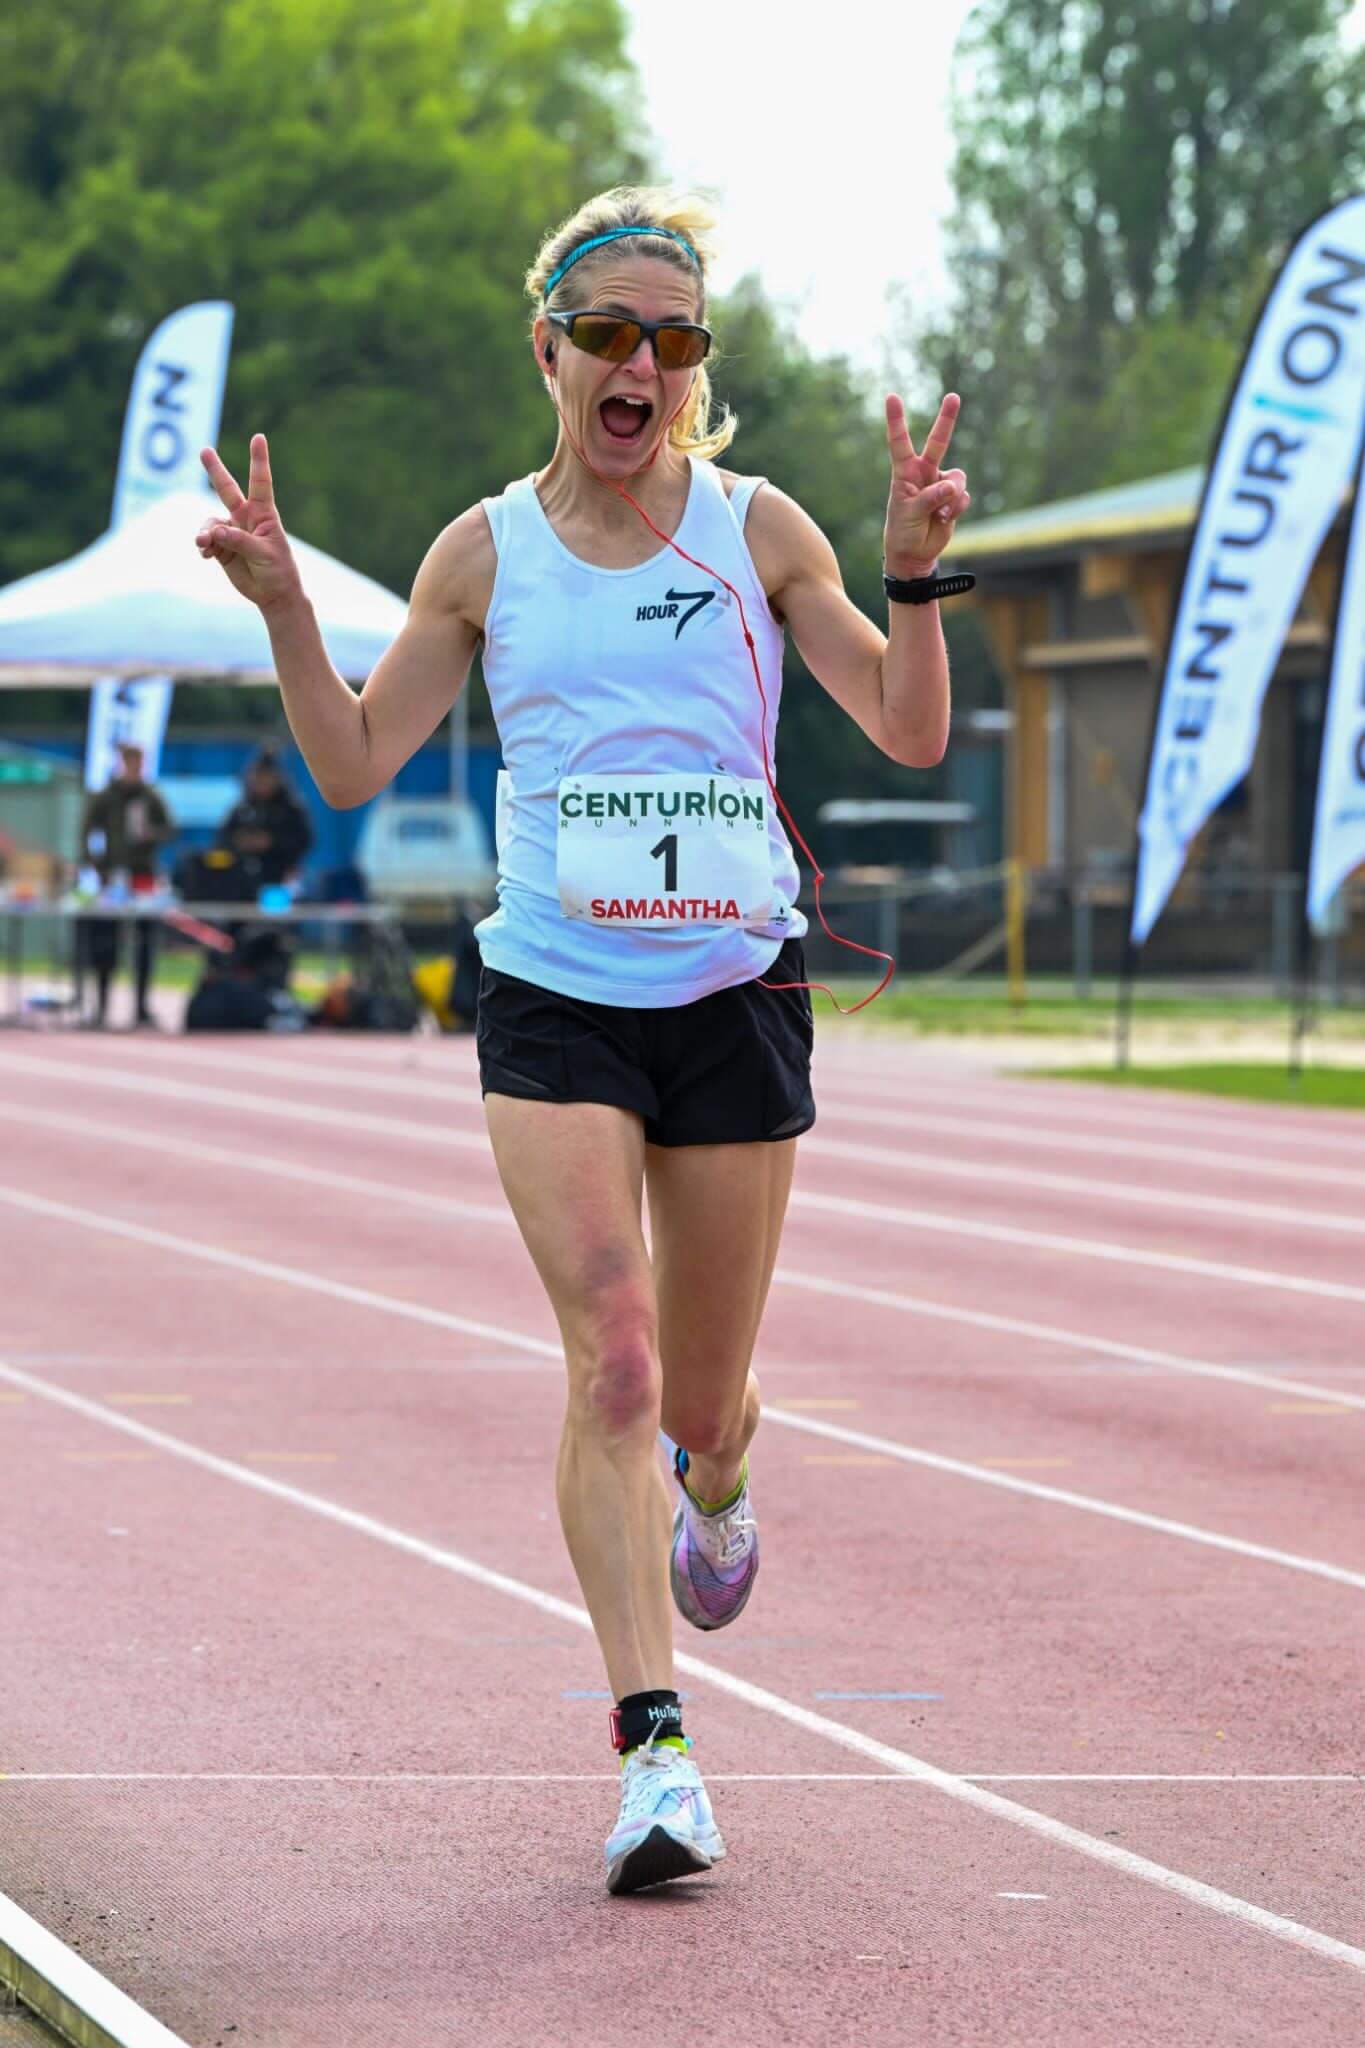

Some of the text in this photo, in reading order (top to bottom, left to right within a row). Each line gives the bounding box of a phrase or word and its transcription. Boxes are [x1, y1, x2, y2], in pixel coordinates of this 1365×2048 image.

[636, 587, 716, 641] HOUR 7
[560, 778, 764, 822] CENTURION
[650, 834, 678, 892] 1
[590, 898, 741, 920] SAMANTHA
